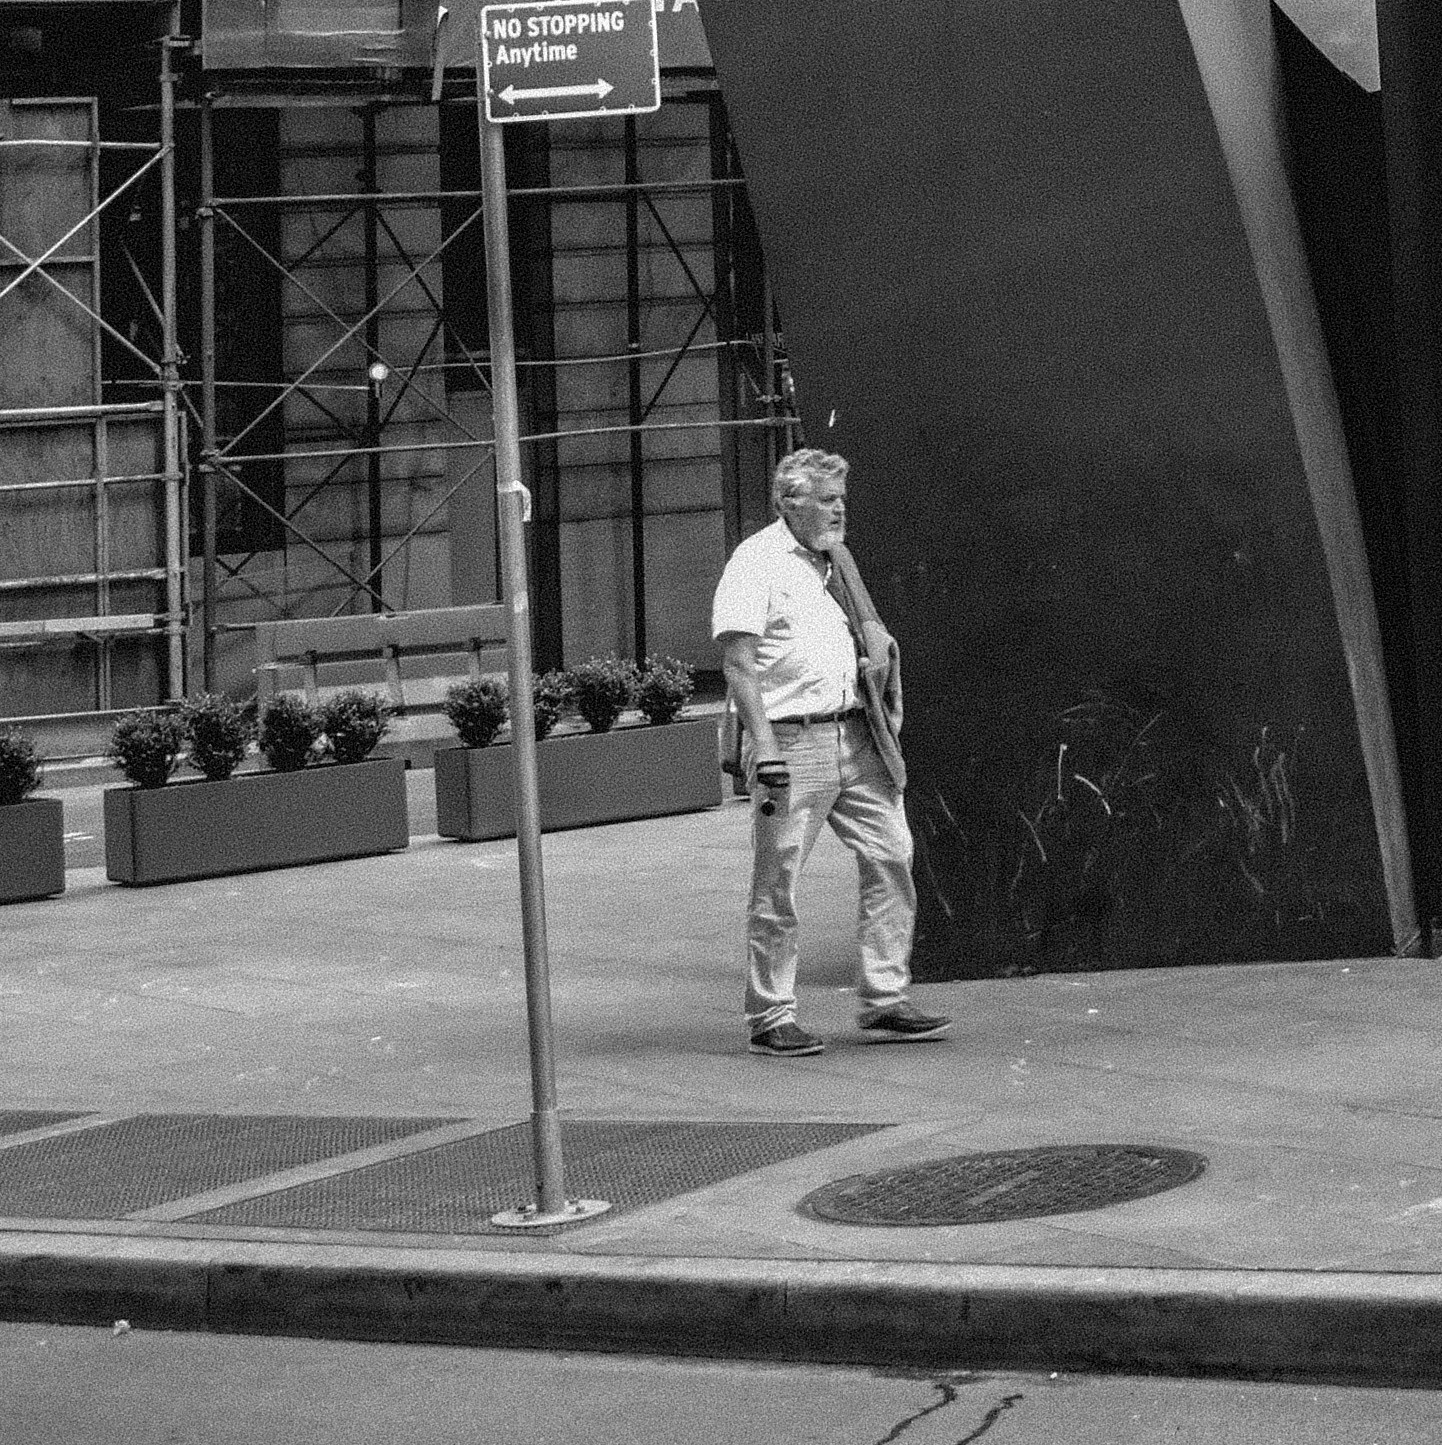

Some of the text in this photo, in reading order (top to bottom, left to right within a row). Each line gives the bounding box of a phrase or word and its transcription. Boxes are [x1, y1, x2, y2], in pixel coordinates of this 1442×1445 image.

[493, 11, 625, 40] NO STOPPING
[495, 41, 578, 68] Anytime
